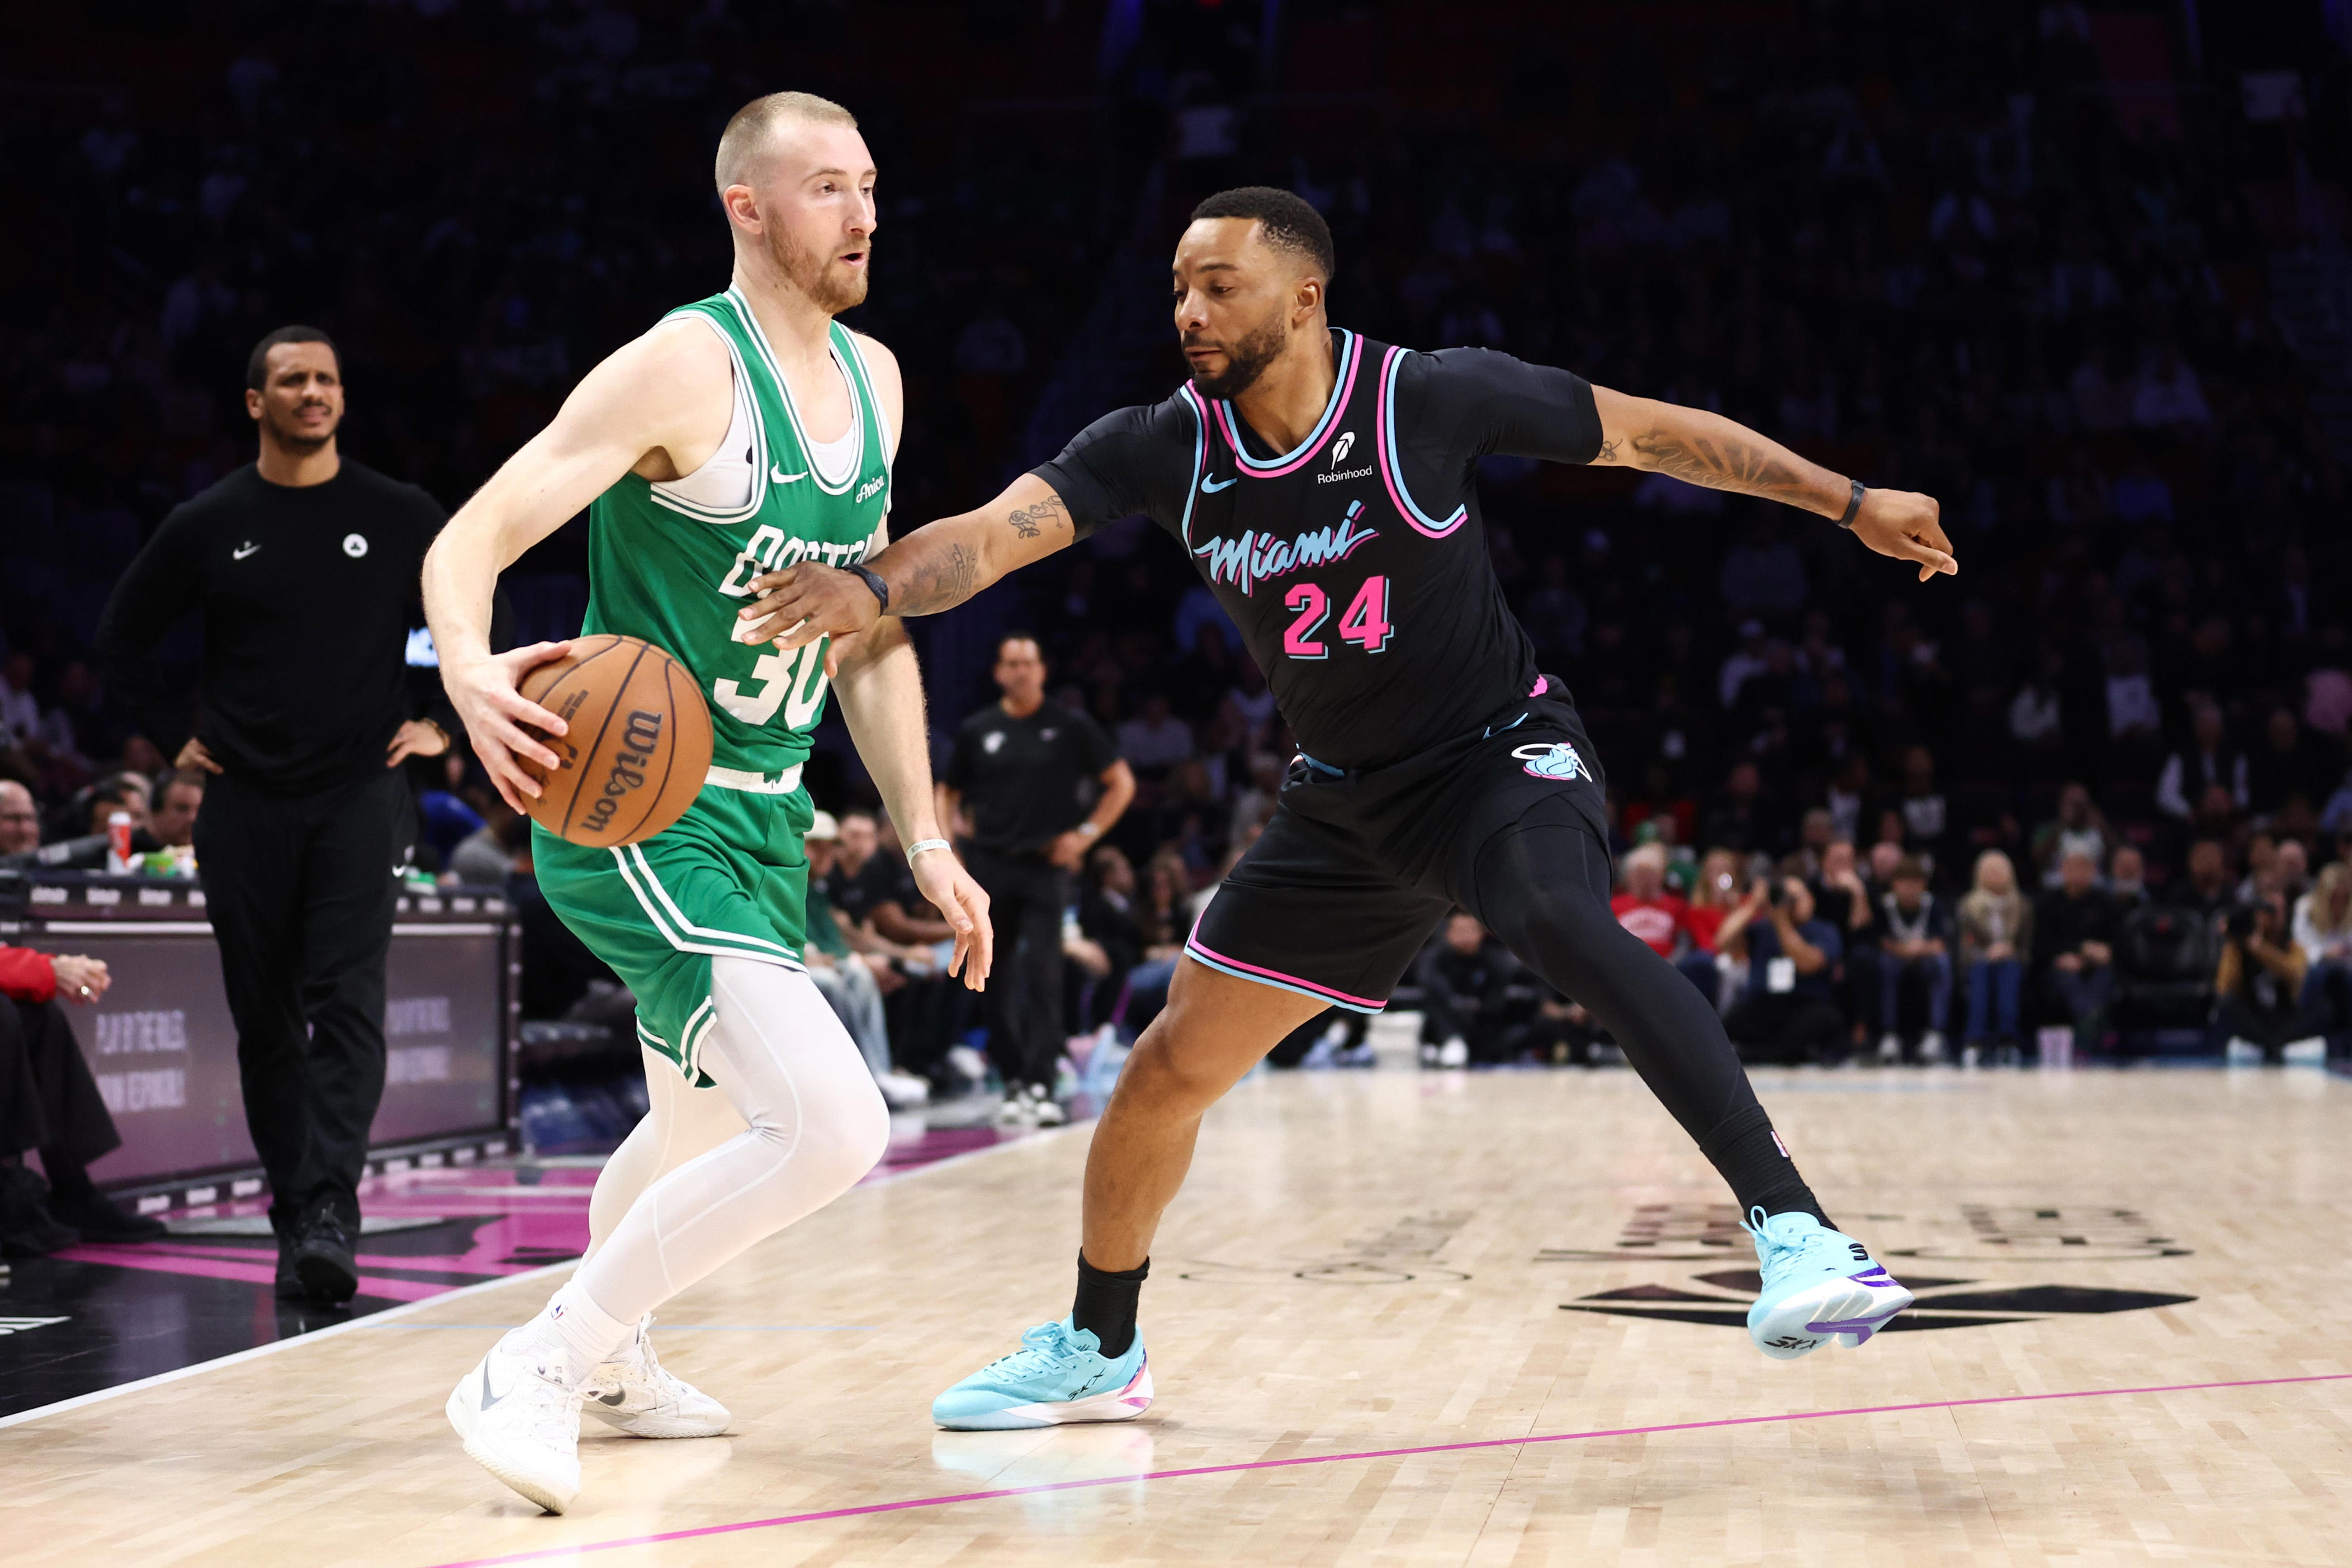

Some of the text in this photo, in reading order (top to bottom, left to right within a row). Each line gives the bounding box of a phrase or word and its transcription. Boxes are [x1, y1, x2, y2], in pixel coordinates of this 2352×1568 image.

[1317, 466, 1373, 484] Robinhood
[1192, 500, 1380, 597] Miami
[1284, 575, 1394, 660] 24
[713, 612, 830, 731] 30
[580, 709, 664, 832] Wilson
